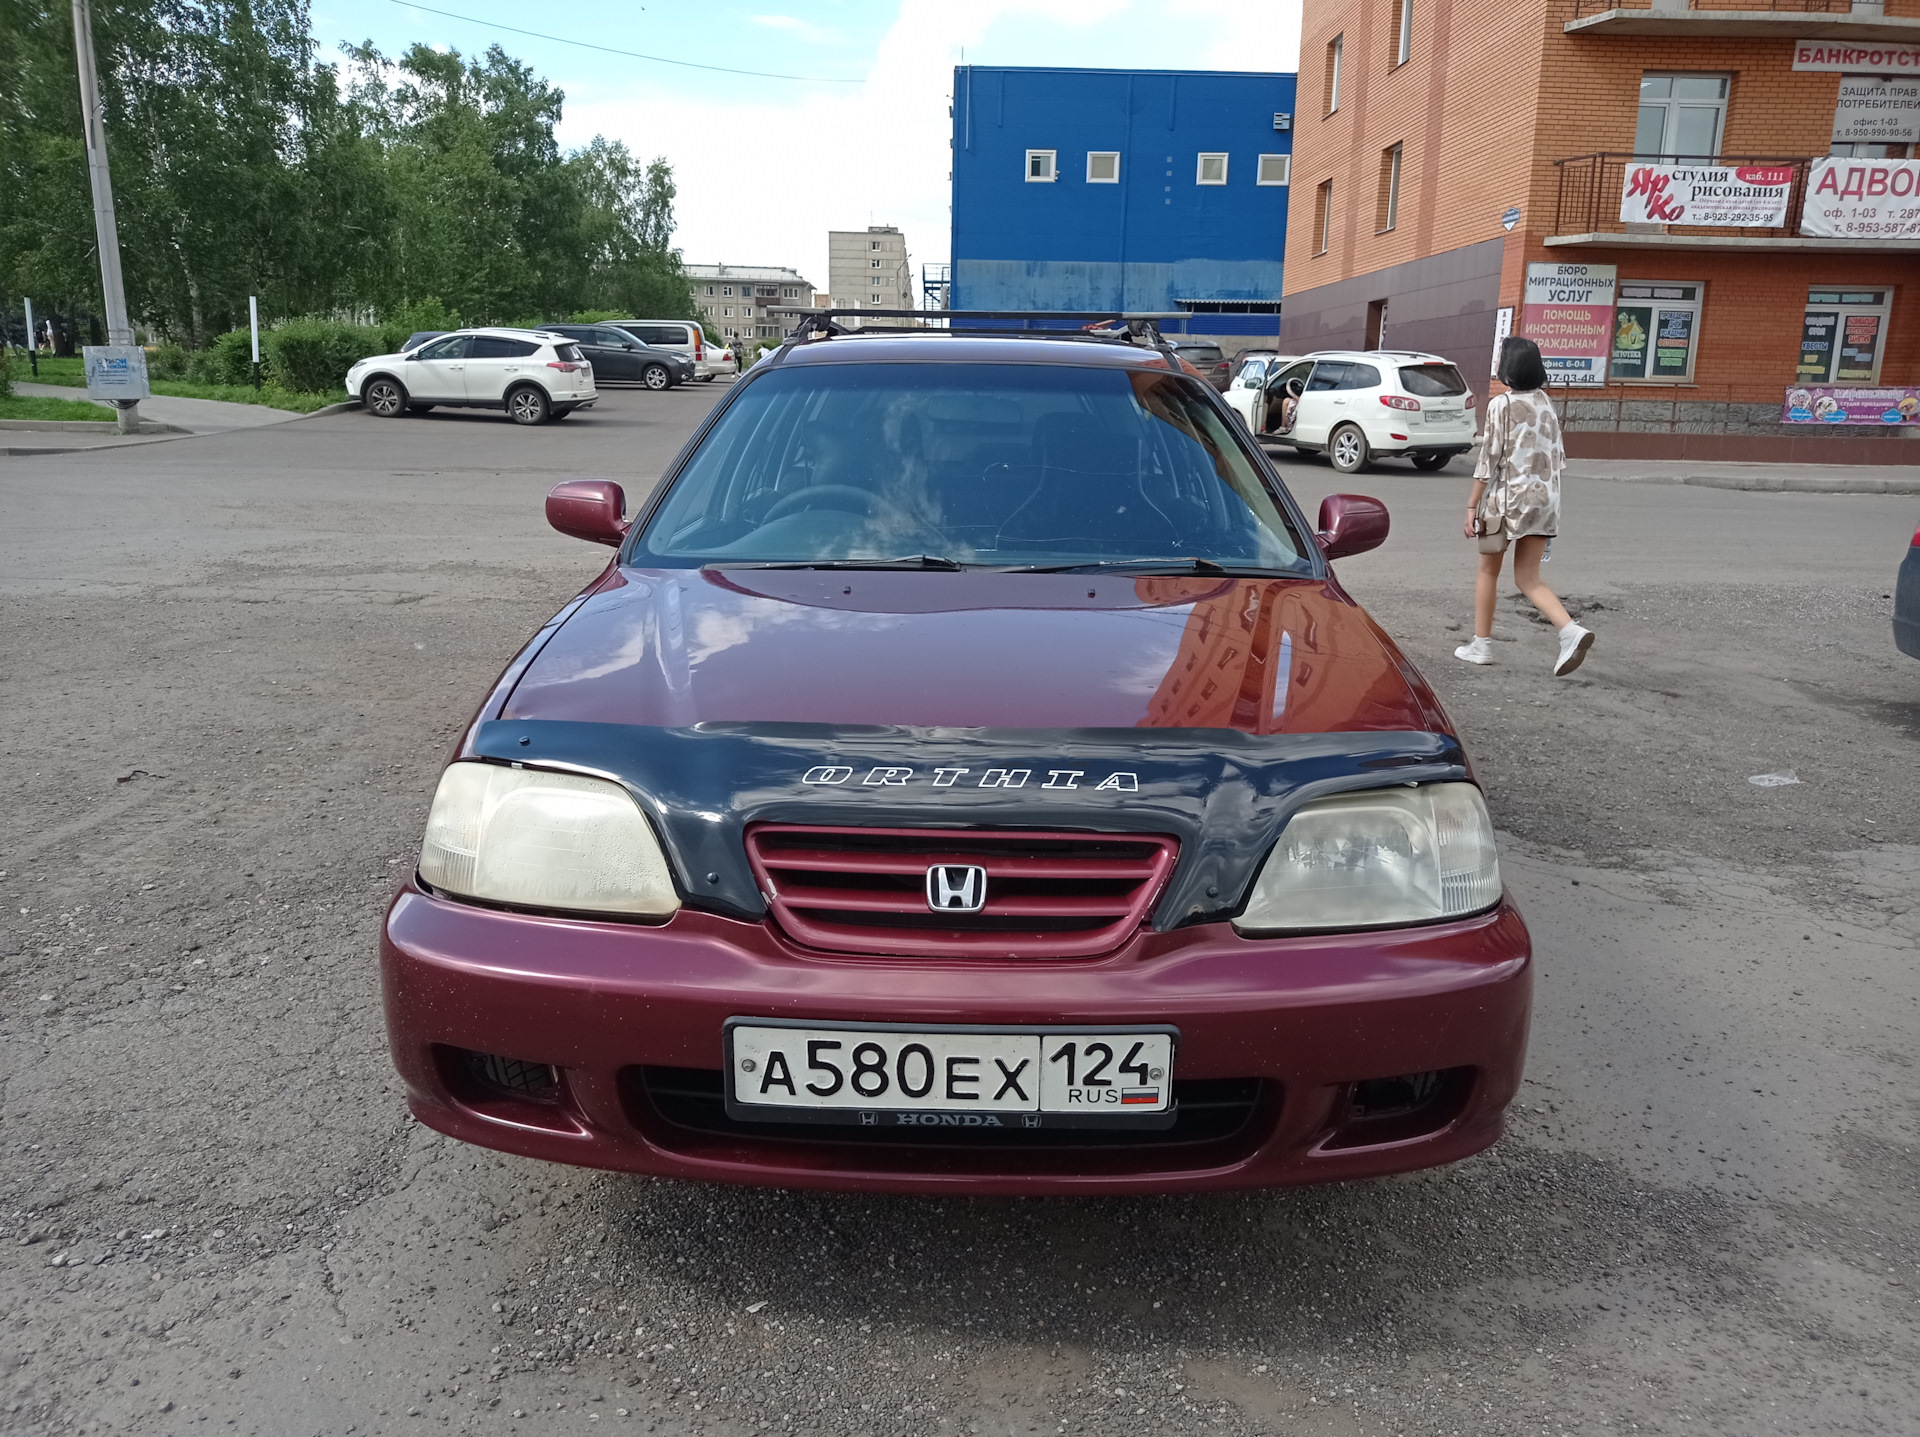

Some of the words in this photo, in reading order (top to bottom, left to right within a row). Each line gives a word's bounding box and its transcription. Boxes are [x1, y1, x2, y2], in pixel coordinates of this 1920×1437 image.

[1842, 87, 1887, 97] ЗАЩИТА
[1889, 88, 1917, 97] ПРАВ
[1836, 99, 1920, 109] ПОТРЕБИТЕЛЕЙ
[1853, 118, 1878, 127] офис
[1880, 118, 1898, 126] 1-03
[1845, 128, 1912, 137] 8-950-990-90-56
[1672, 170, 1728, 187] студия
[1745, 171, 1764, 181] каб.
[1767, 172, 1784, 181] 111
[1815, 167, 1920, 202] АДВО
[1691, 184, 1784, 202] рисования
[1703, 212, 1774, 222] 8-923-292-35-95
[1823, 207, 1846, 220] оф.
[1851, 208, 1877, 218] 1-03
[1887, 210, 1895, 219] т.
[1834, 224, 1842, 232] т.
[1557, 266, 1588, 276] БЮРО
[1528, 277, 1615, 288] МИГРАЦИОННЫХ
[1548, 290, 1593, 303] УСЛУГ
[1543, 309, 1591, 322] ПОМОЩЬ
[1525, 323, 1605, 335] ИНОСТРАННЫМ
[1533, 338, 1597, 349] ГРАЖДАНАМ
[1801, 342, 1828, 350] КВЕСТЫ
[1542, 360, 1564, 369] фис
[1566, 360, 1585, 368] 6-04
[801, 765, 1139, 792] ORTHIA
[760, 1040, 1030, 1101] А580ЕХ
[1049, 1041, 1149, 1086] 124
[1068, 1088, 1119, 1104] RUS
[896, 1113, 1004, 1127] HONDA
